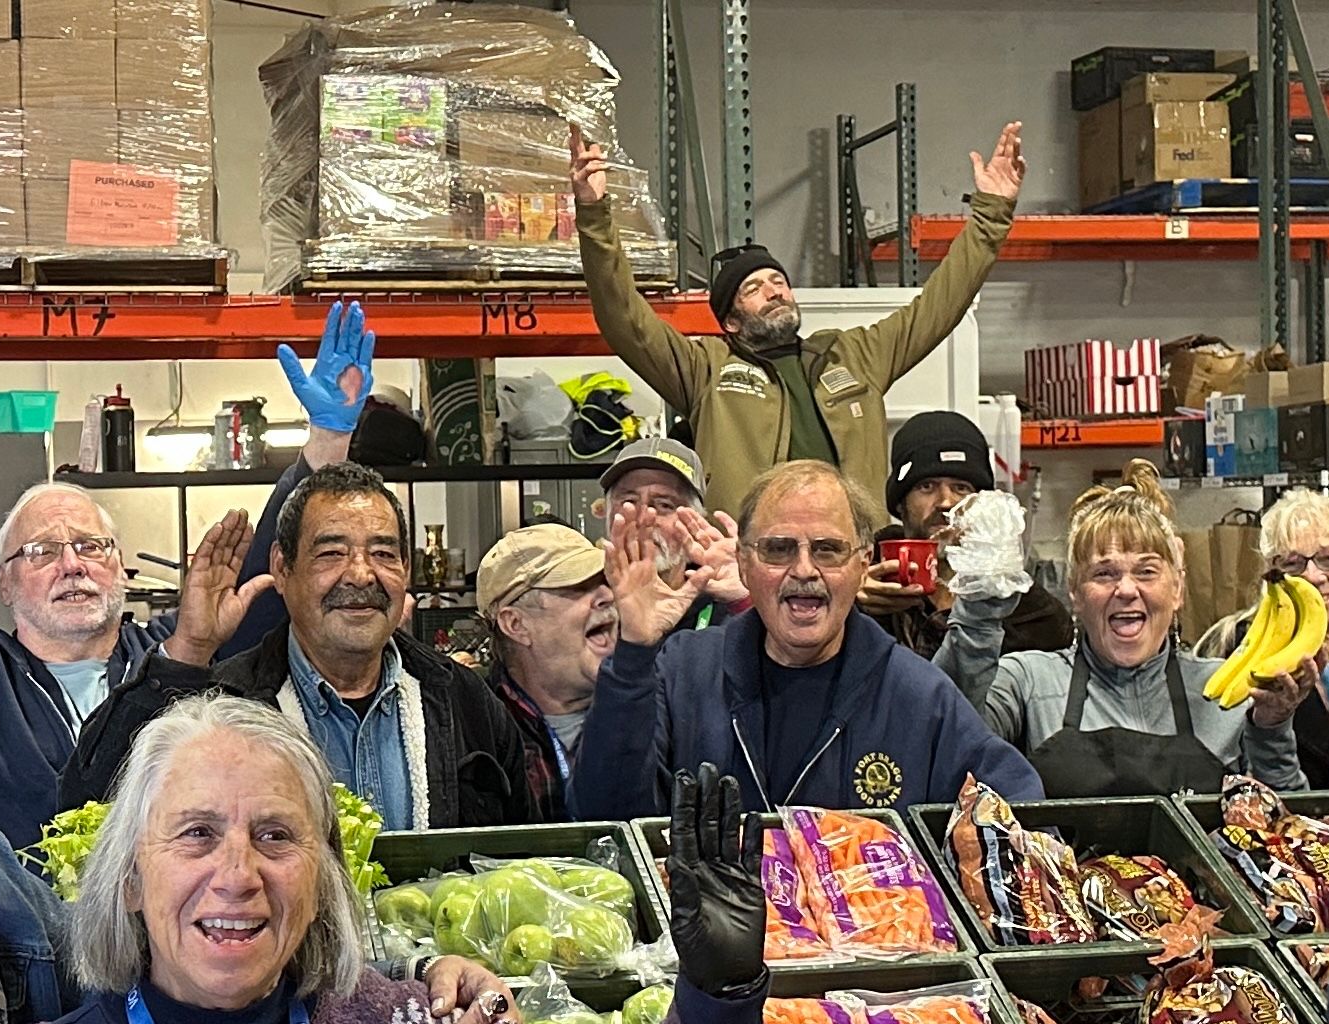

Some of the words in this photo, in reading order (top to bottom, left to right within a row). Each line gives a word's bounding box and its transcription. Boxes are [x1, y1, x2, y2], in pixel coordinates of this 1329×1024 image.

[95, 176, 155, 189] PURCHASED
[1171, 217, 1183, 235] B
[42, 297, 116, 338] M7
[481, 300, 538, 336] M8
[1040, 421, 1082, 446] M21
[854, 752, 877, 775] FORT
[878, 752, 902, 783] BRAGG
[876, 786, 902, 807] BANK
